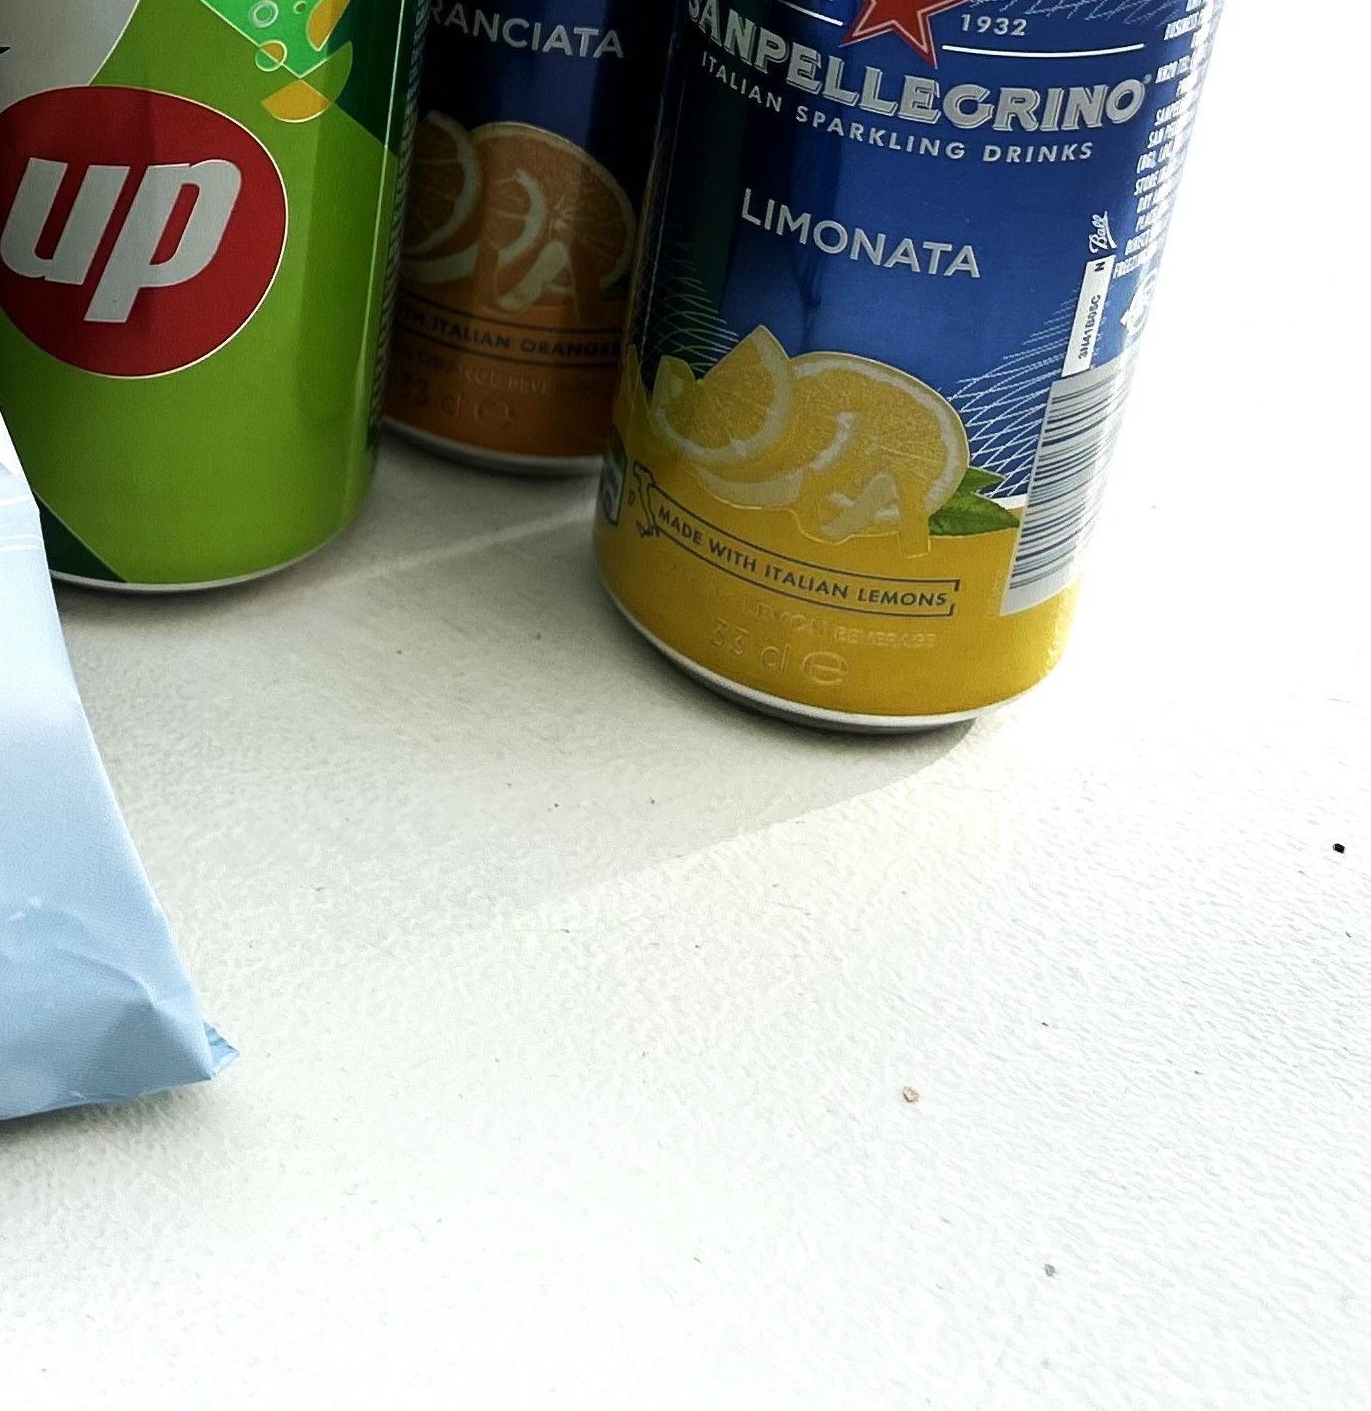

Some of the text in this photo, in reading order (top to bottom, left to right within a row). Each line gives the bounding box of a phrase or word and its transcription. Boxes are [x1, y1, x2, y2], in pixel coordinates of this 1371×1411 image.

[960, 13, 1029, 38] 1932
[702, 55, 783, 113] ITALIAN
[796, 104, 966, 162] SPARKLING
[982, 140, 1094, 165] DRINKS
[740, 188, 981, 279] LIMONATA
[1088, 210, 1117, 254] Ball
[432, 314, 511, 350] ITALIAN
[657, 503, 948, 608] MADE WITH ITALIAN LEMONS
